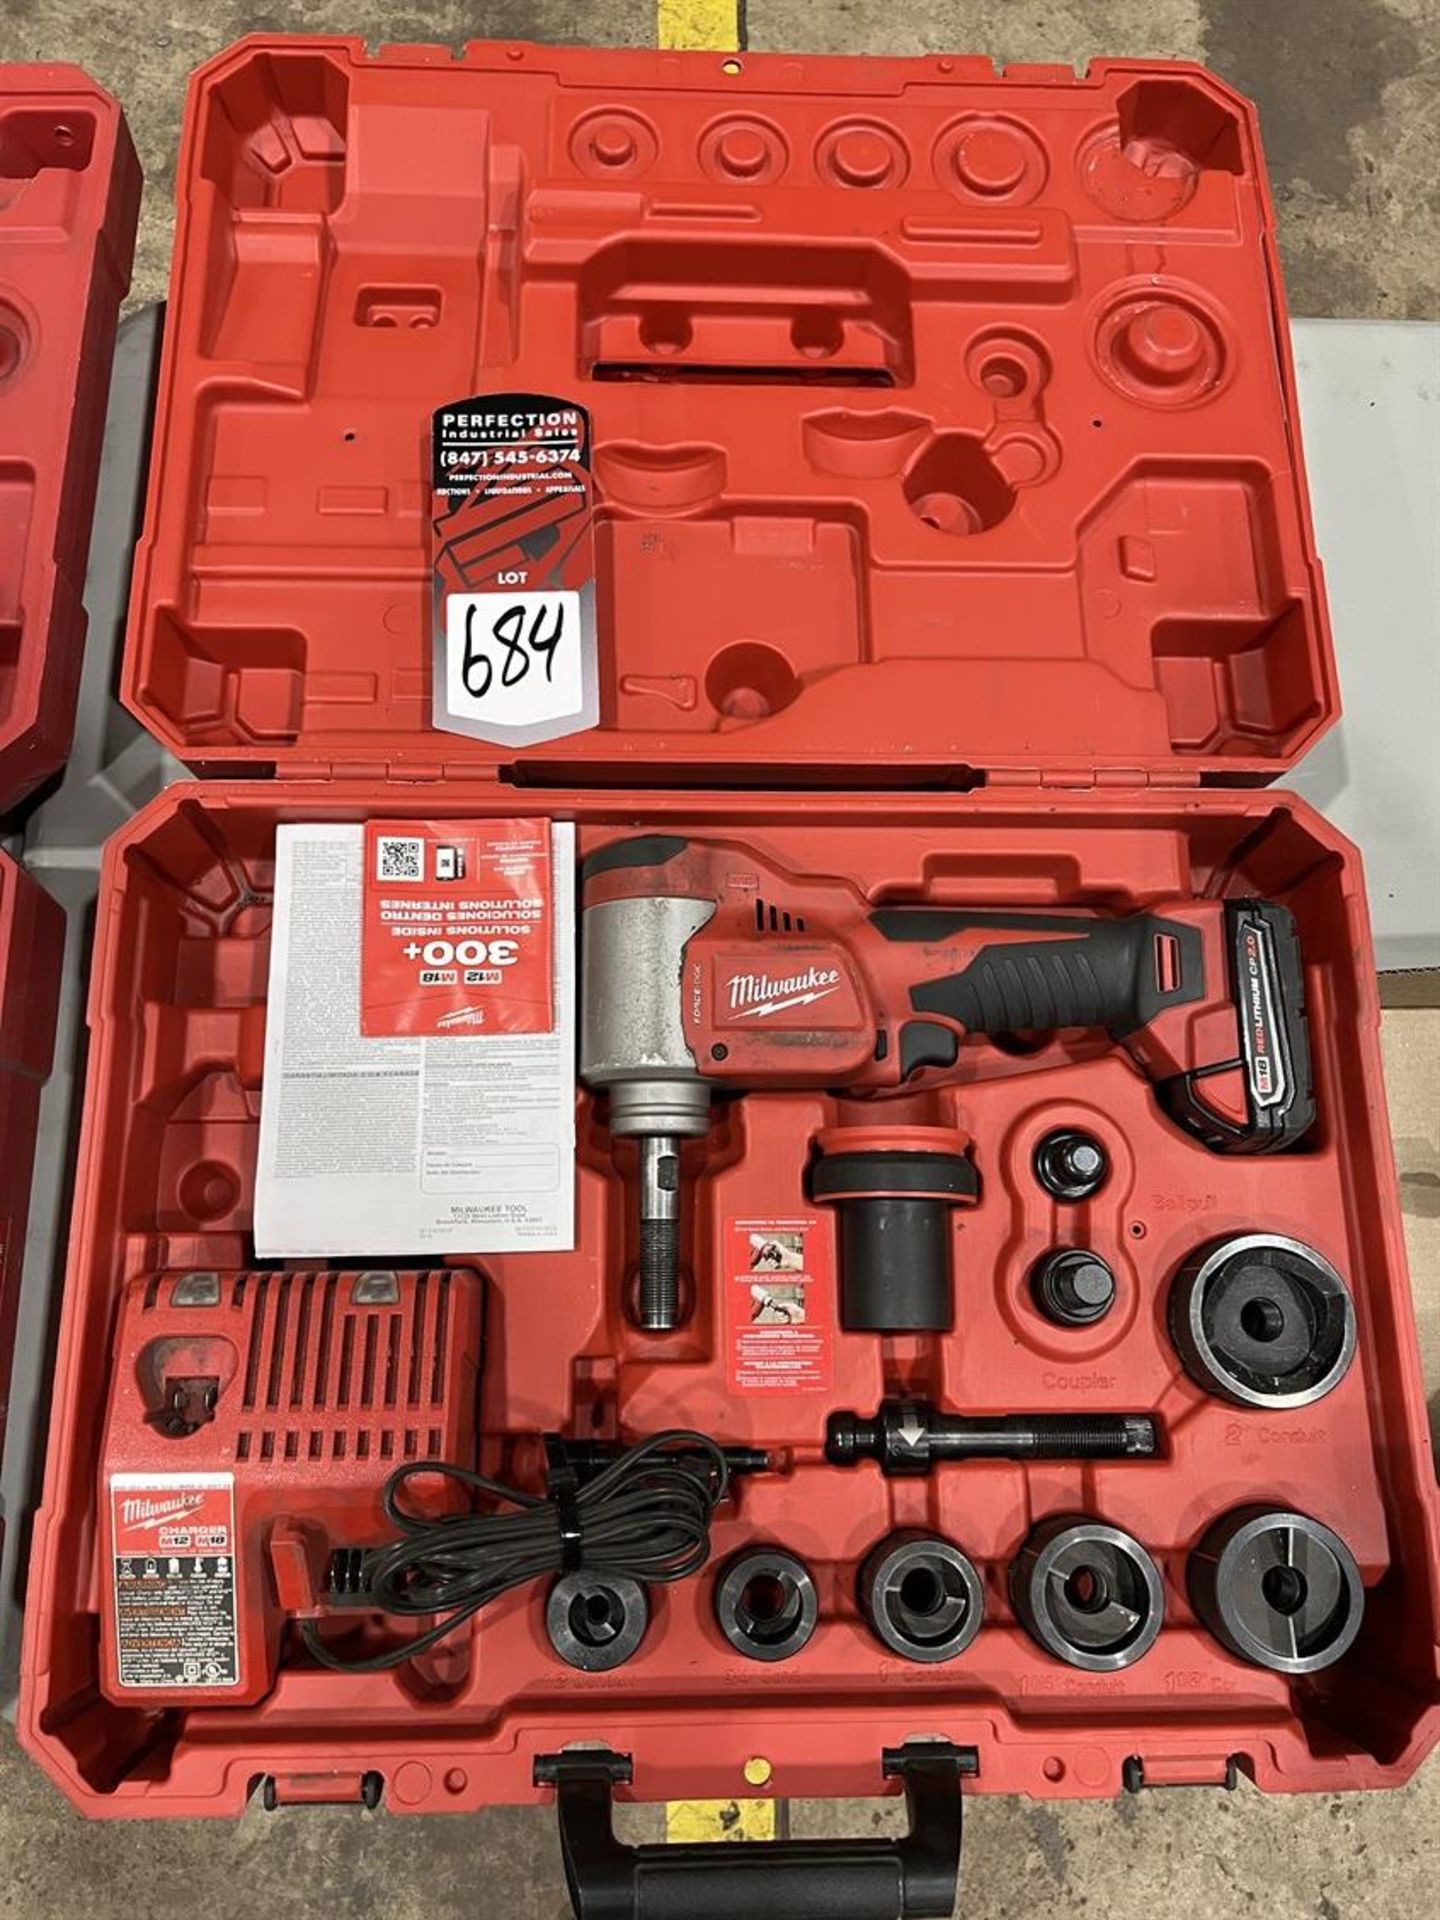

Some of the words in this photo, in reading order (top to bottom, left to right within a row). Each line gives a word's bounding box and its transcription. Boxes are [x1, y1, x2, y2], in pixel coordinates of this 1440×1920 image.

[443, 411, 577, 427] PERFECTION
[442, 428, 526, 439] Industrial
[534, 426, 578, 437] Sales
[440, 451, 488, 467] (847)
[493, 449, 581, 464] 545-6374
[449, 472, 573, 481] PERFECTIONINDUSTRIAL.COM
[497, 572, 528, 585] LOT
[461, 602, 565, 698] 684
[380, 899, 455, 910] INTERNES
[458, 899, 543, 910] SOLUTIONS
[380, 911, 442, 921] DENTRO
[446, 910, 542, 921] SOLUCIONES
[391, 926, 442, 937] INSIDE
[446, 925, 531, 936] SOLUTIONS
[403, 940, 520, 966] 300+
[422, 971, 455, 982] M18
[466, 971, 500, 982] M12
[724, 966, 841, 1009] Milwaukee
[1251, 975, 1265, 1054] REDLITHIUM
[1258, 1060, 1271, 1090] M18
[118, 1492, 205, 1524] Milwaukee
[159, 1525, 227, 1535] CHARGER
[161, 1536, 189, 1545] M12
